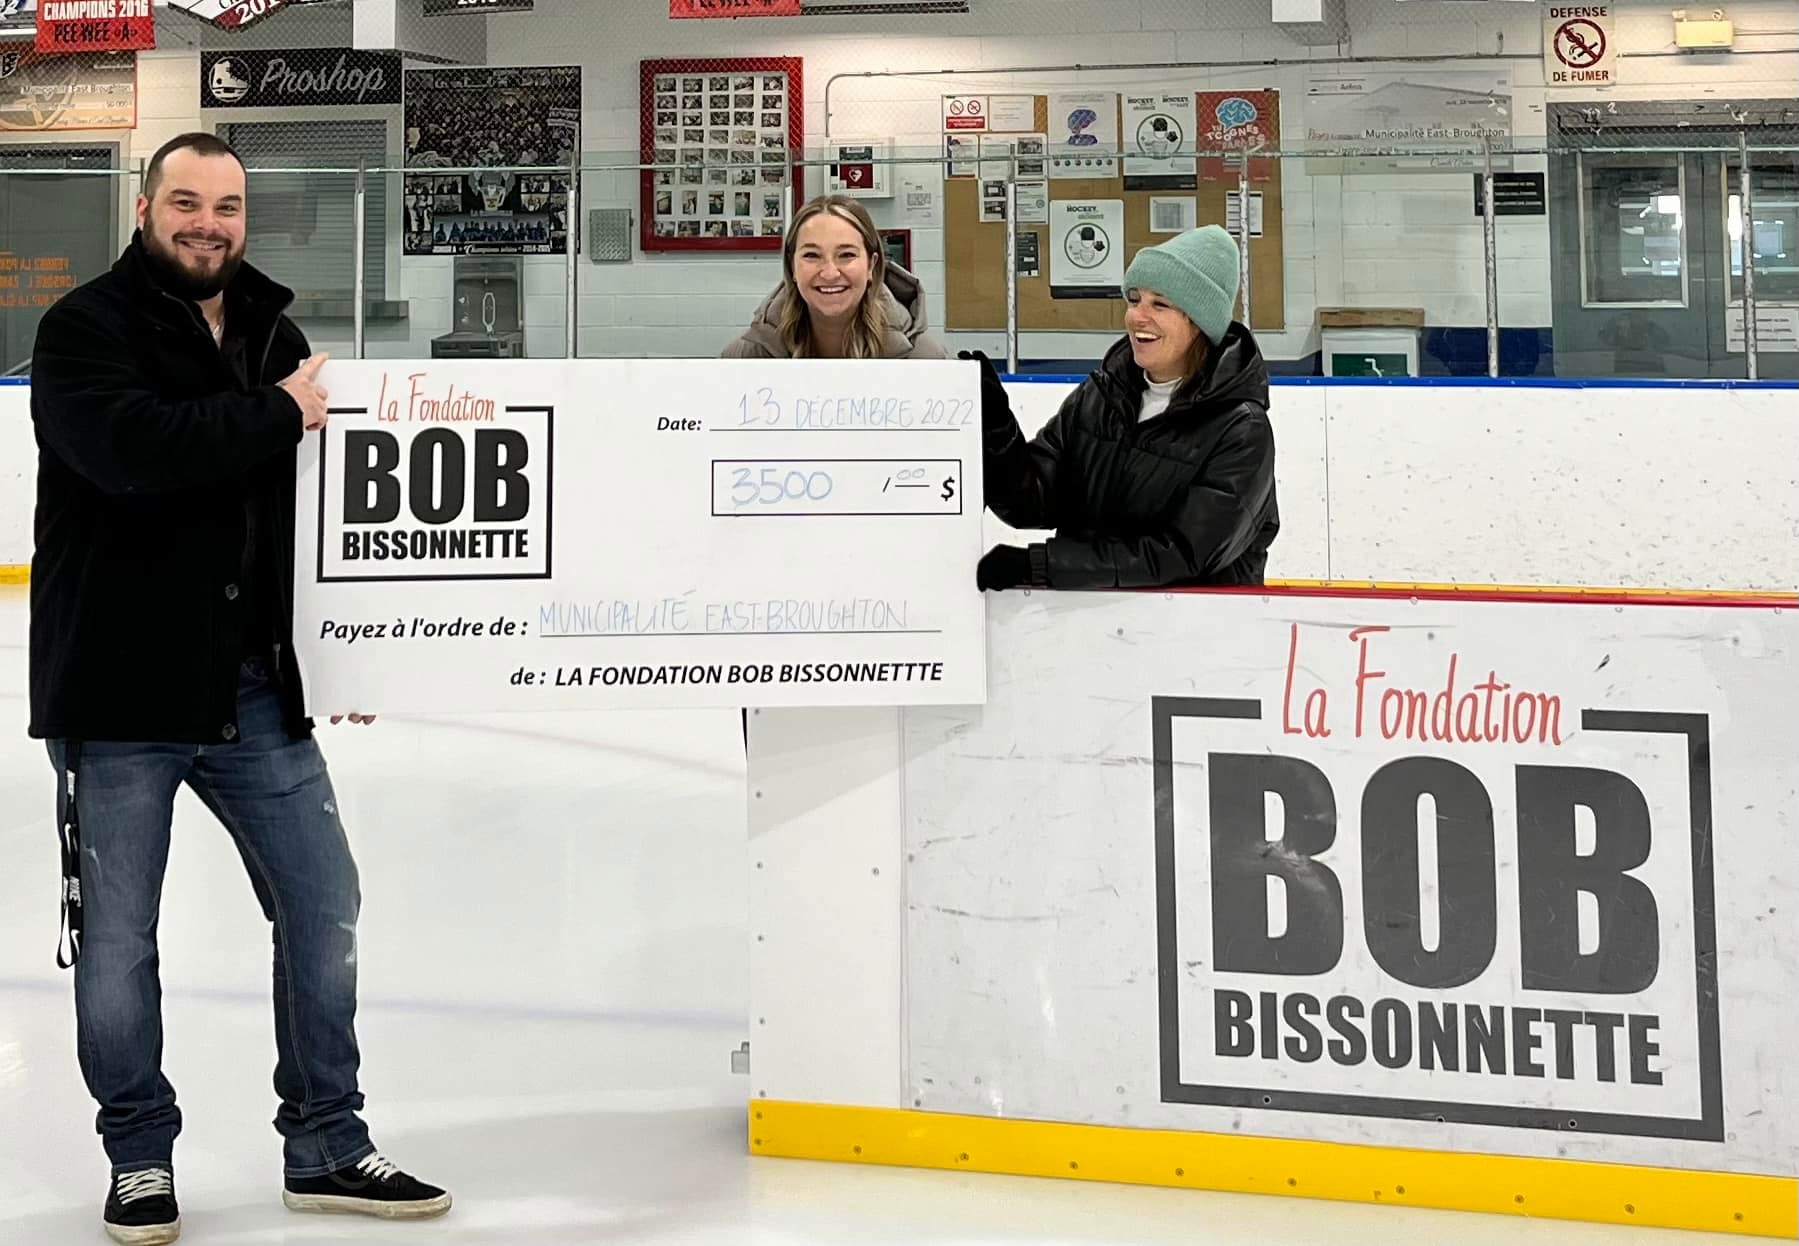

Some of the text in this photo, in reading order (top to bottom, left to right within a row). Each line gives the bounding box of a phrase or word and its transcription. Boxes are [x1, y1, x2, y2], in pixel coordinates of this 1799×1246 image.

[44, 1, 116, 20] CHAMPIONS
[1550, 6, 1608, 18] DEFENSE
[260, 54, 387, 103] Proshop
[1553, 70, 1609, 82] DE FUMER
[378, 372, 495, 422] La Fondation
[737, 387, 781, 426] 13
[920, 398, 975, 426] 2022
[657, 416, 702, 431] Date:
[343, 427, 530, 525] BOB
[731, 467, 834, 505] 3500
[940, 475, 955, 501] $
[342, 529, 529, 560] BISSONNETTE
[539, 589, 697, 634] MUNICIPALITÉ
[320, 620, 387, 645] Payez
[391, 618, 406, 638] à
[410, 617, 484, 638] l'ordre
[555, 667, 583, 687] LA
[588, 664, 722, 687] FONDATION
[727, 664, 774, 684] BOB
[779, 661, 943, 682] BISSONNETTTE
[1282, 622, 1562, 746] La Fondation
[1207, 751, 1660, 995] BOB
[1213, 988, 1664, 1086] BISSONNETTE
